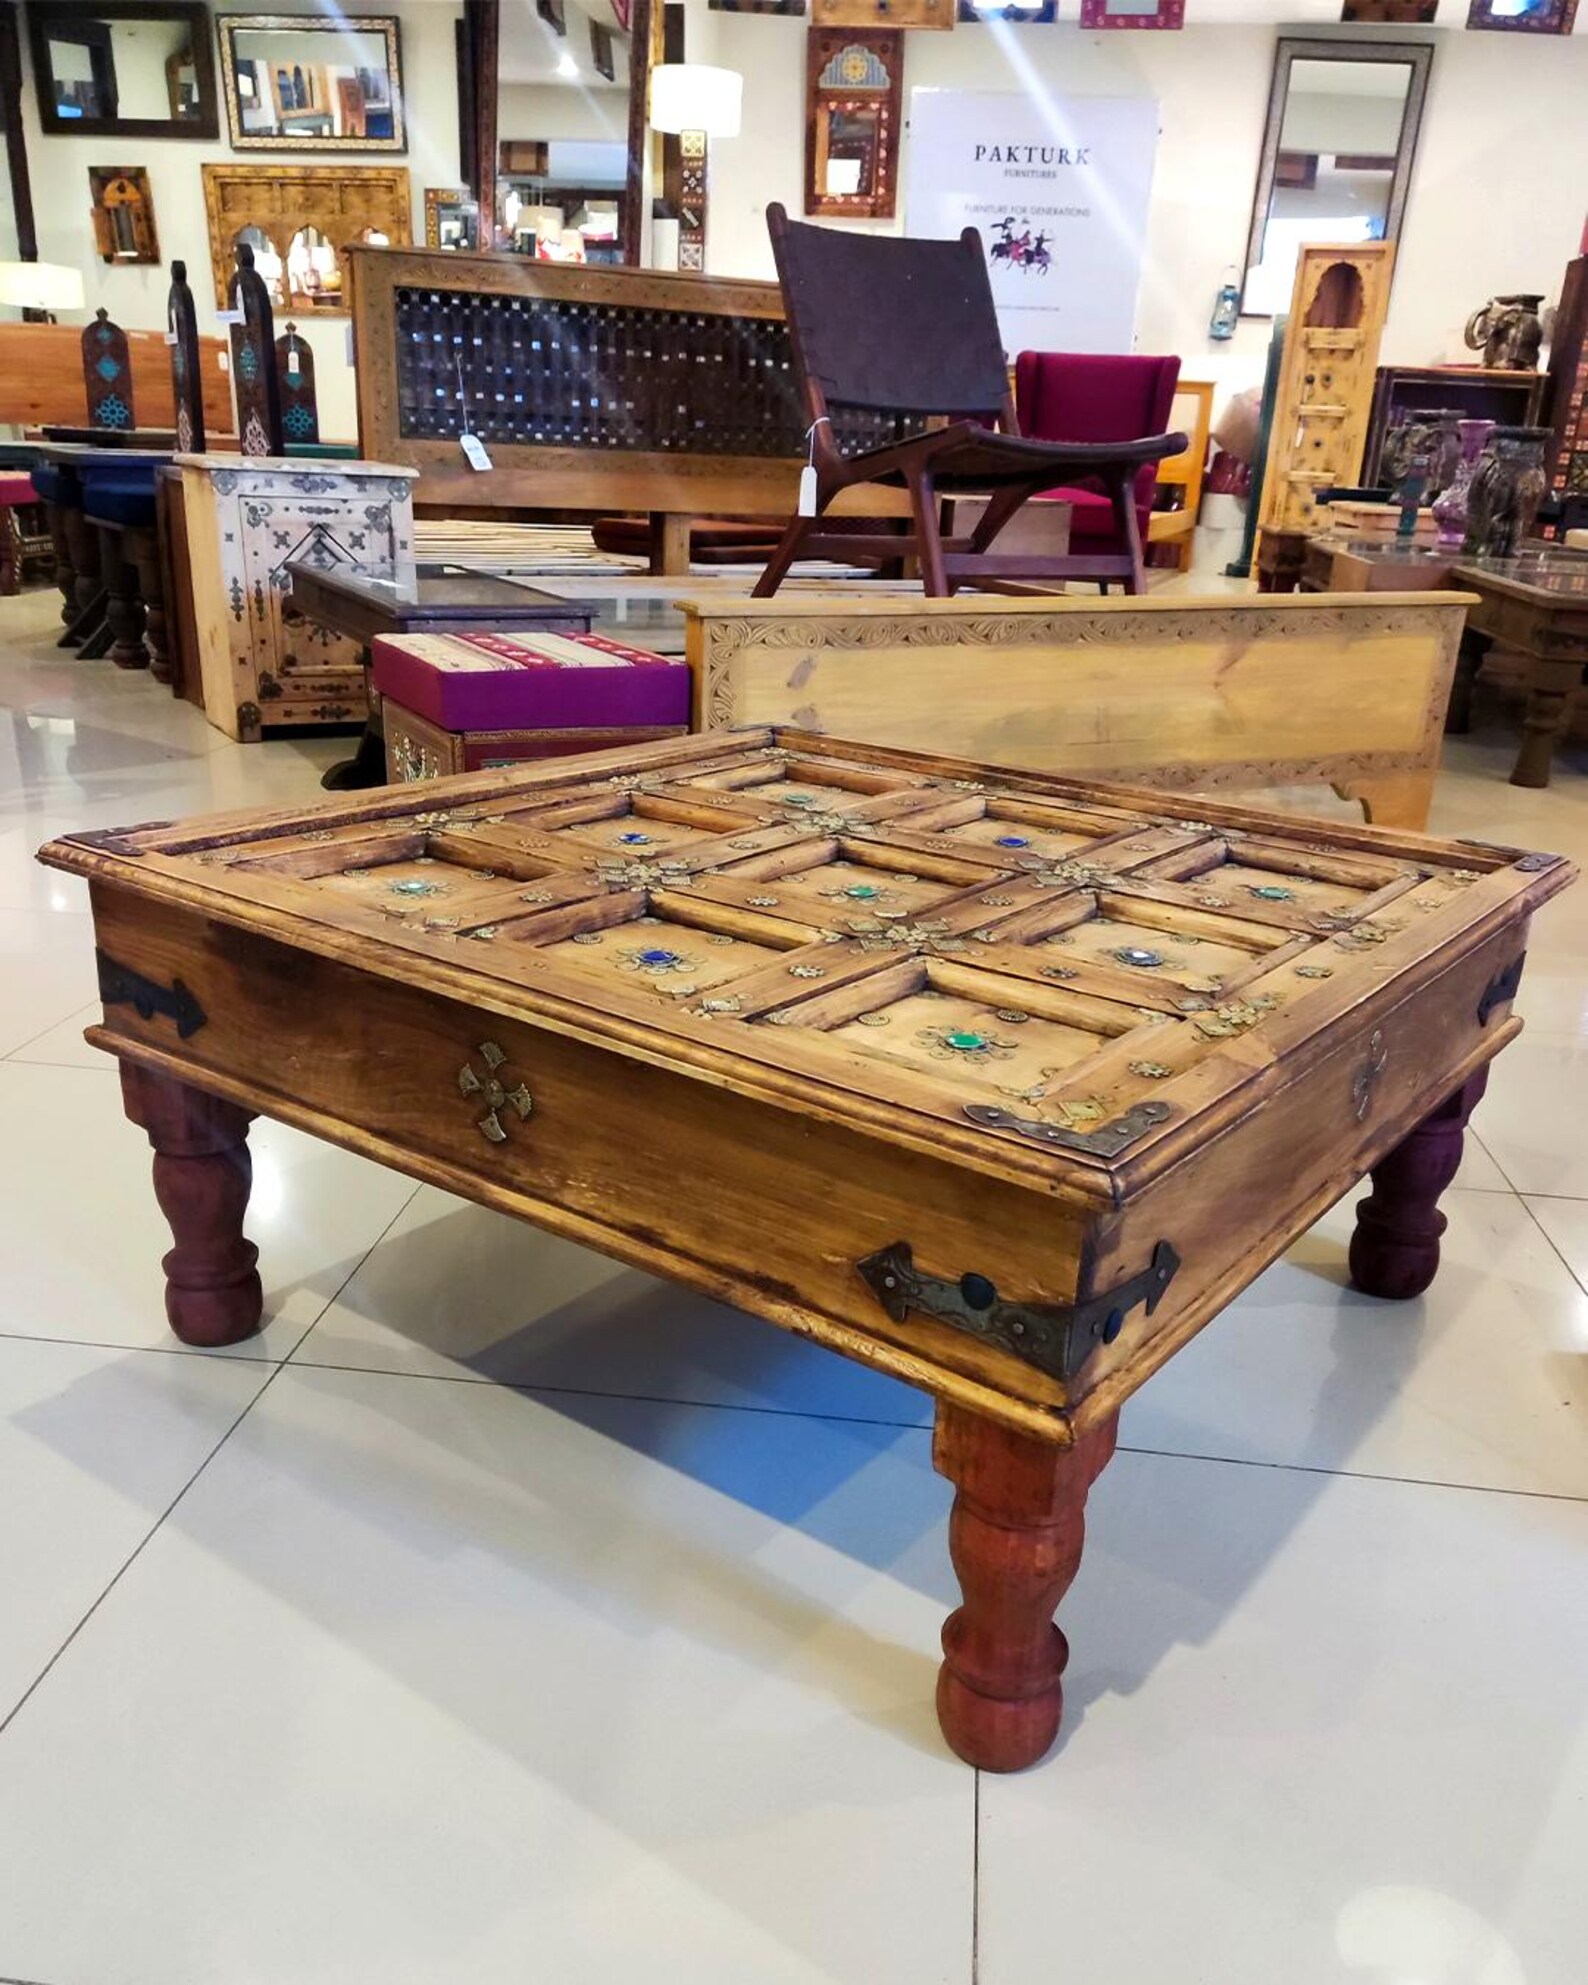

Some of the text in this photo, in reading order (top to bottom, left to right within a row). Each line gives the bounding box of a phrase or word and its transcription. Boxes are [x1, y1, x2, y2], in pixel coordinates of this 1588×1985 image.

[975, 145, 1090, 165] PAKTURK
[1004, 169, 1057, 179] FURNITURES
[1010, 204, 1028, 215] FOR
[1030, 206, 1091, 217] GENERATIONS
